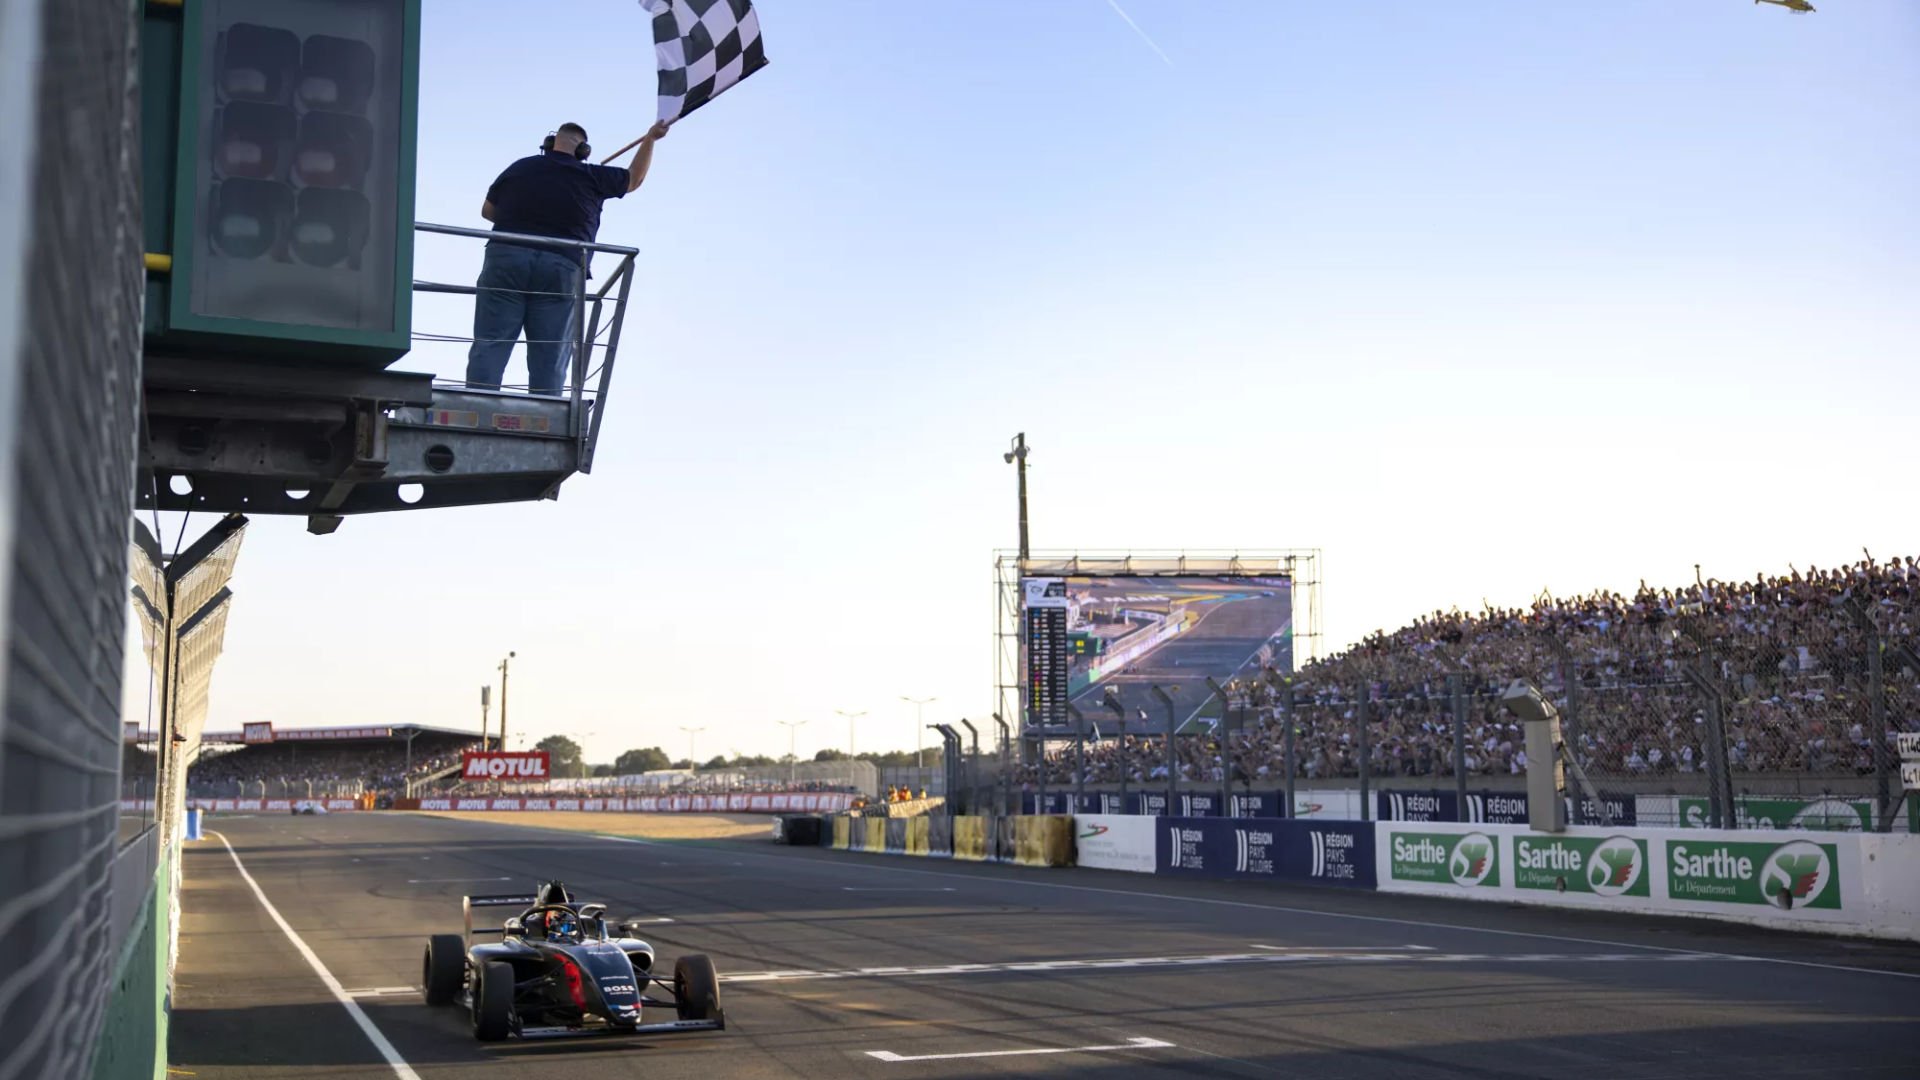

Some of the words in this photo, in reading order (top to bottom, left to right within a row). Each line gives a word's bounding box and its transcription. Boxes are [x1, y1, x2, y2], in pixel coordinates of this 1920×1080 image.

[467, 757, 546, 776] MOTUL
[420, 799, 450, 810] MOTUL
[456, 799, 487, 810] MOTUL
[492, 799, 520, 810] MOTUL
[1487, 796, 1525, 814] RÉGION
[1182, 828, 1203, 842] RÉGION
[1249, 830, 1273, 845] RÉGION
[1326, 832, 1354, 848] RÉGION
[1183, 843, 1196, 855] PAYS
[1249, 845, 1265, 859] PAYS
[1326, 848, 1345, 863] PAYS
[1395, 836, 1446, 864] Sarthe
[1518, 840, 1582, 871] Sarthe
[1673, 845, 1753, 880] Sarthe
[1333, 864, 1354, 879] LOIRE
[1686, 880, 1736, 896] Département
